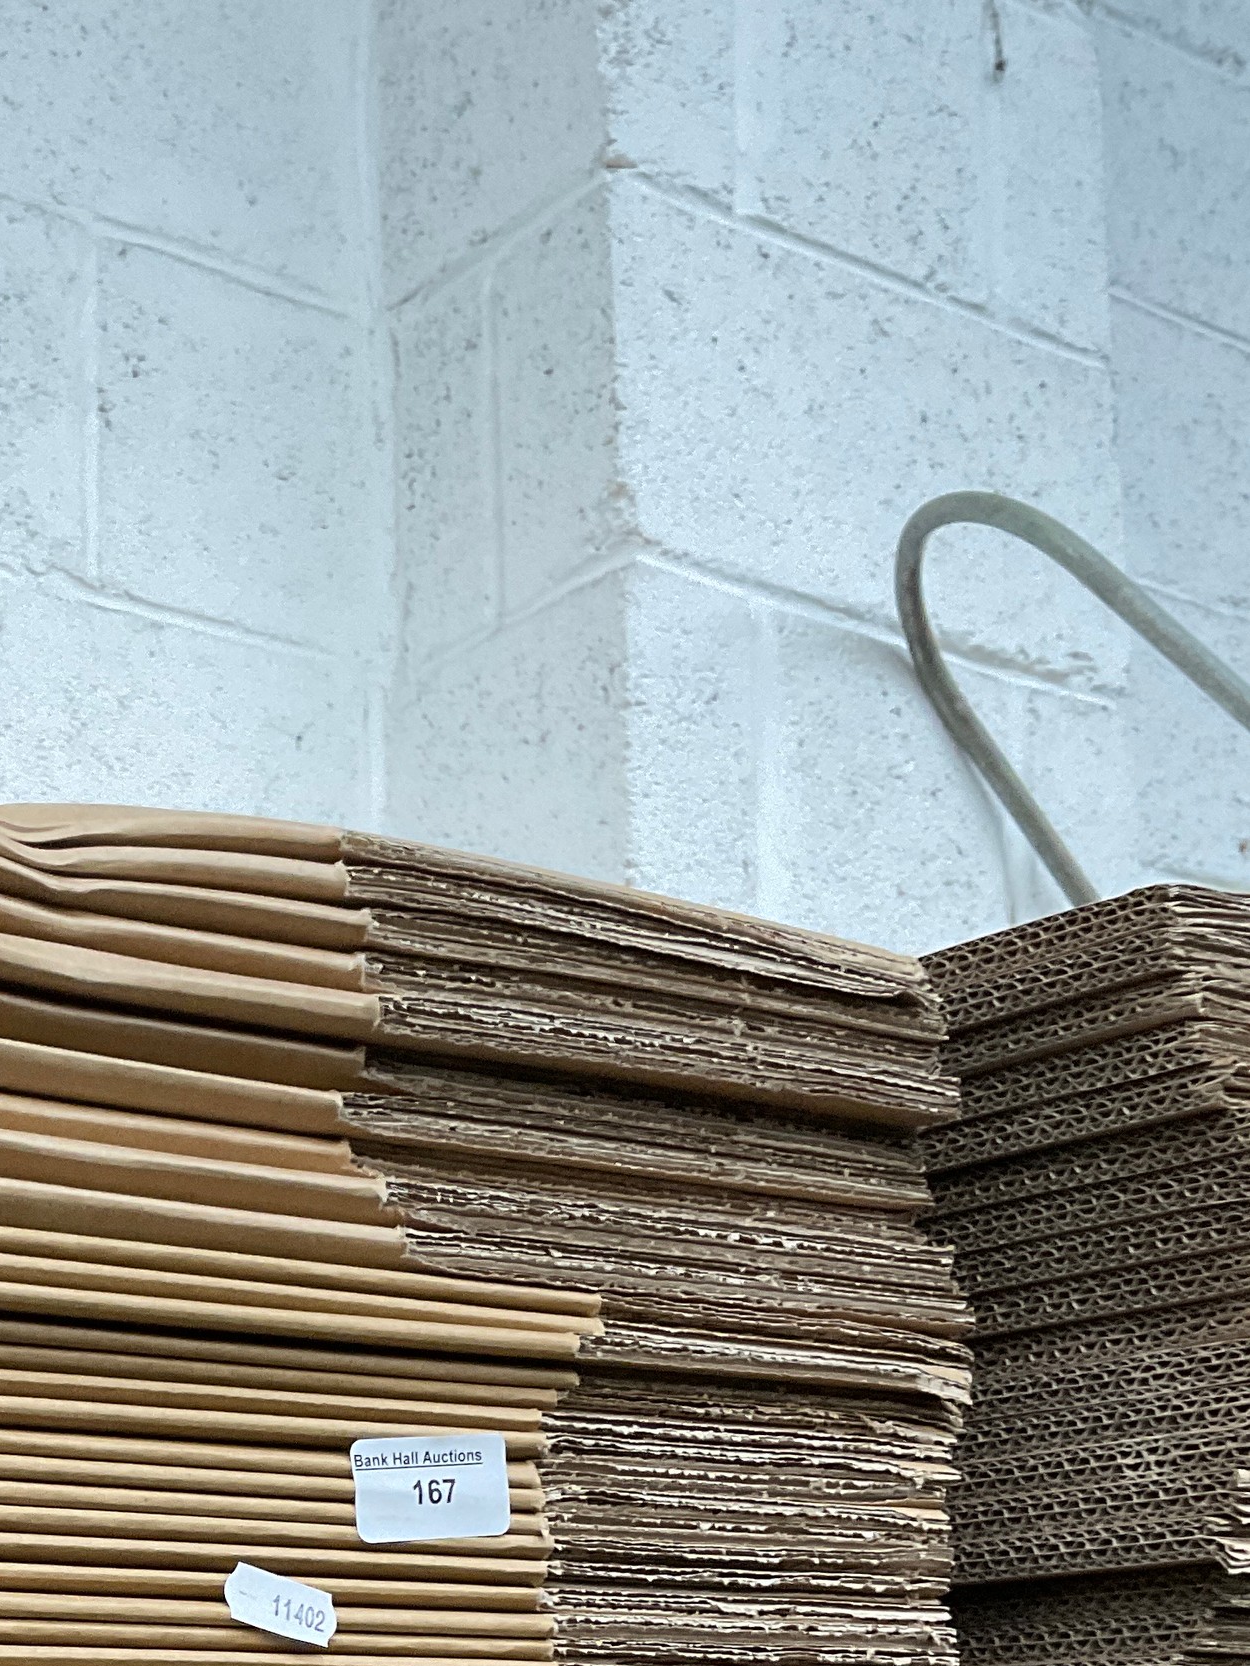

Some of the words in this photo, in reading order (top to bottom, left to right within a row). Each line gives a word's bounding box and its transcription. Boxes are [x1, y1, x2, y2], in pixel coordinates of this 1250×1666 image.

[354, 1453, 388, 1467] Bank
[393, 1452, 419, 1465] Hall
[423, 1449, 482, 1464] Auctions
[413, 1479, 456, 1505] 167
[273, 1594, 325, 1632] 11402
